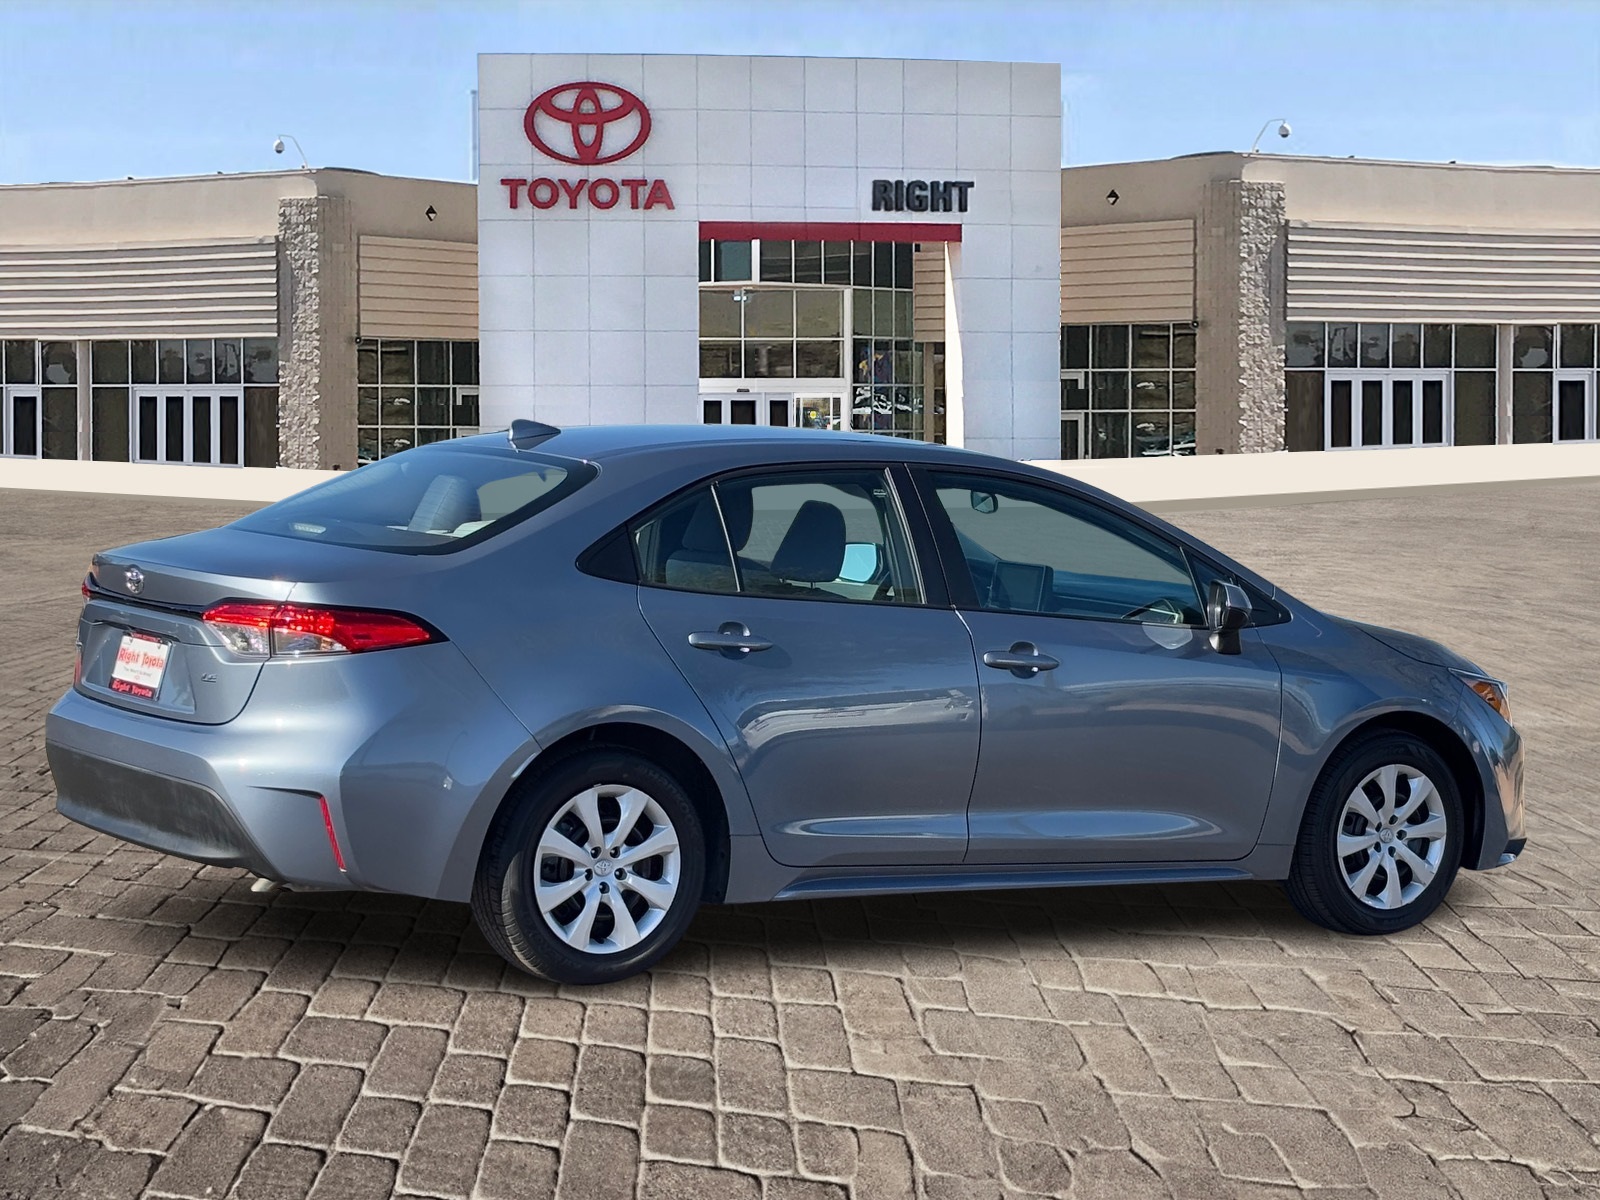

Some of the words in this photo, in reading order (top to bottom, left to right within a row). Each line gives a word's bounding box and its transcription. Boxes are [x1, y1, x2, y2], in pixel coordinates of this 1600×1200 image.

[500, 177, 675, 210] TOYOTA
[872, 179, 975, 212] RIGHT
[118, 647, 140, 664] Right
[142, 651, 164, 669] Toyota
[112, 679, 130, 692] Right
[131, 684, 153, 697] Toyota
